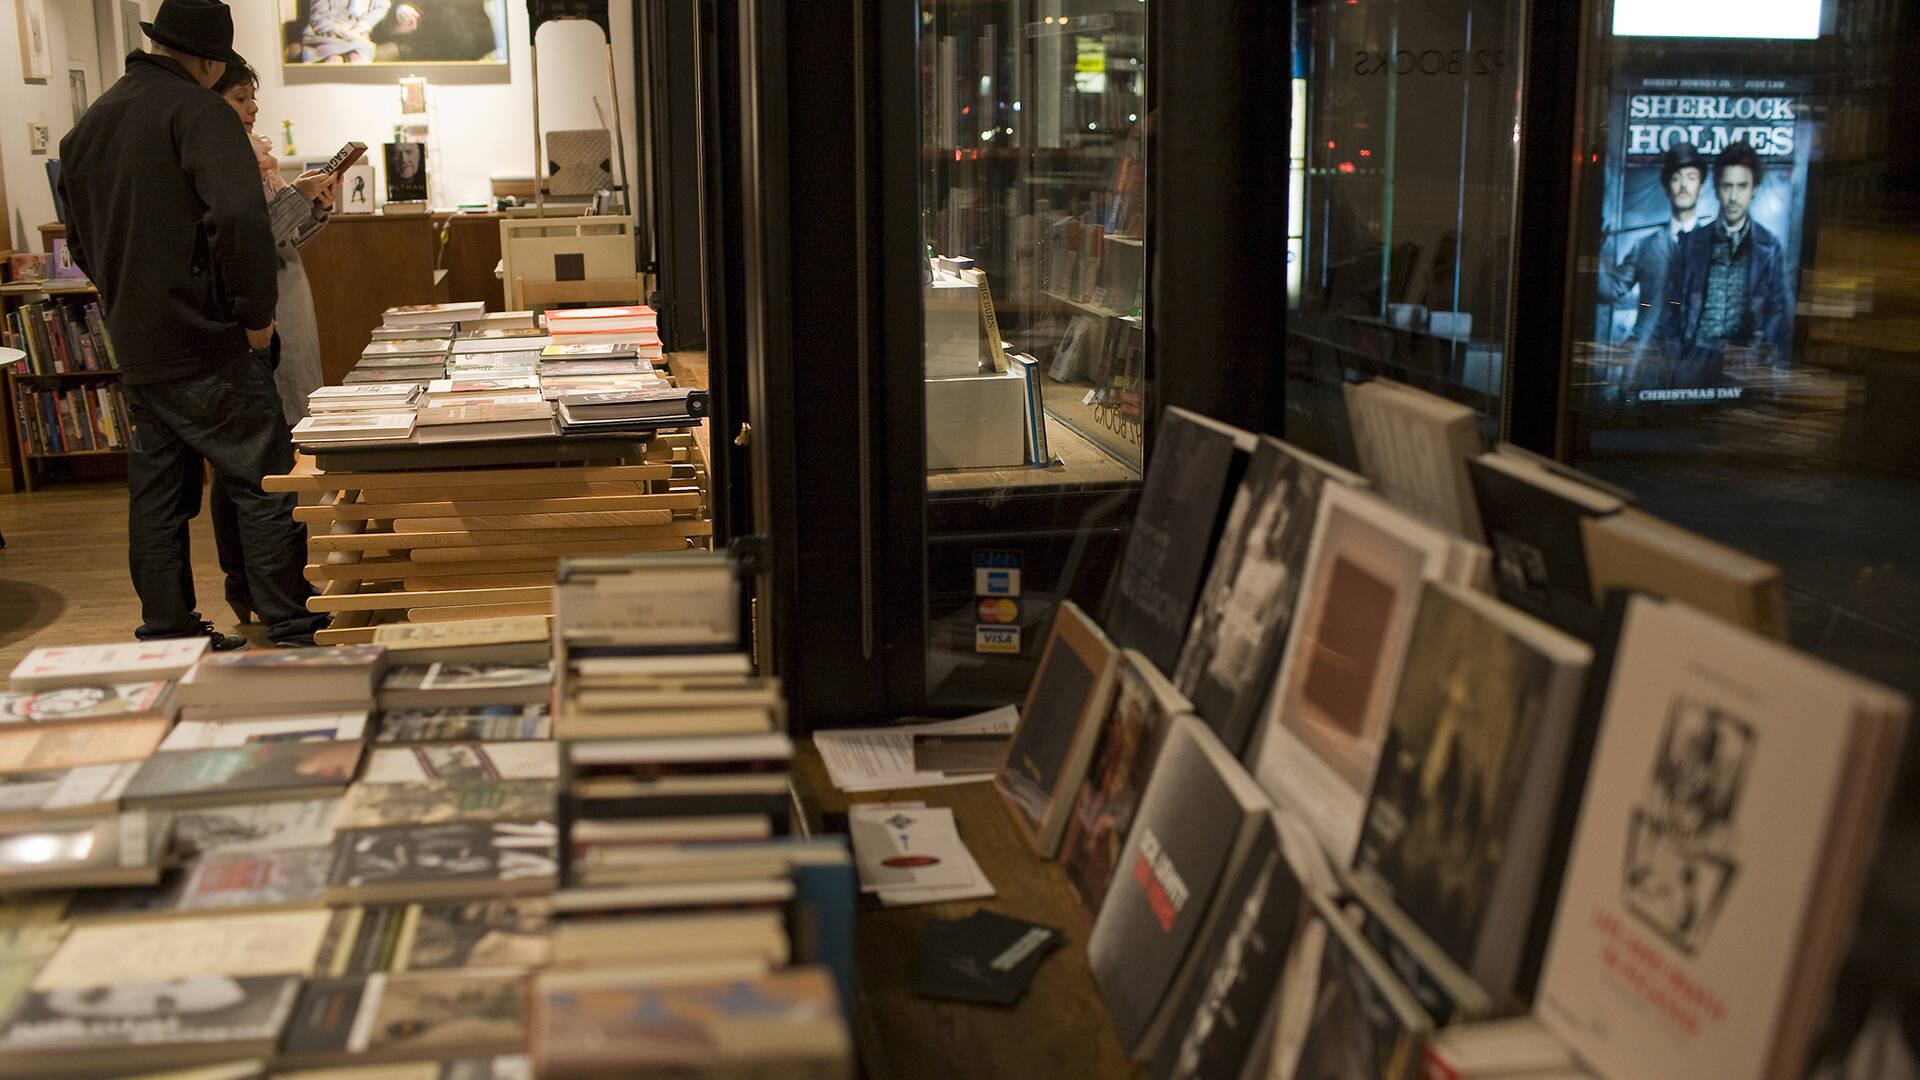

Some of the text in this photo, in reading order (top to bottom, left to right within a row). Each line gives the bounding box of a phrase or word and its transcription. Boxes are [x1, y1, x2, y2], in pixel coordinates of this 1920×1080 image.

[1767, 80, 1786, 89] LAW
[1630, 94, 1796, 120] SHERLOCK
[1627, 124, 1795, 156] HOLMES
[983, 302, 996, 330] BURN
[1639, 386, 1743, 401] CHRISTMAS DAY
[984, 633, 1013, 644] VISA
